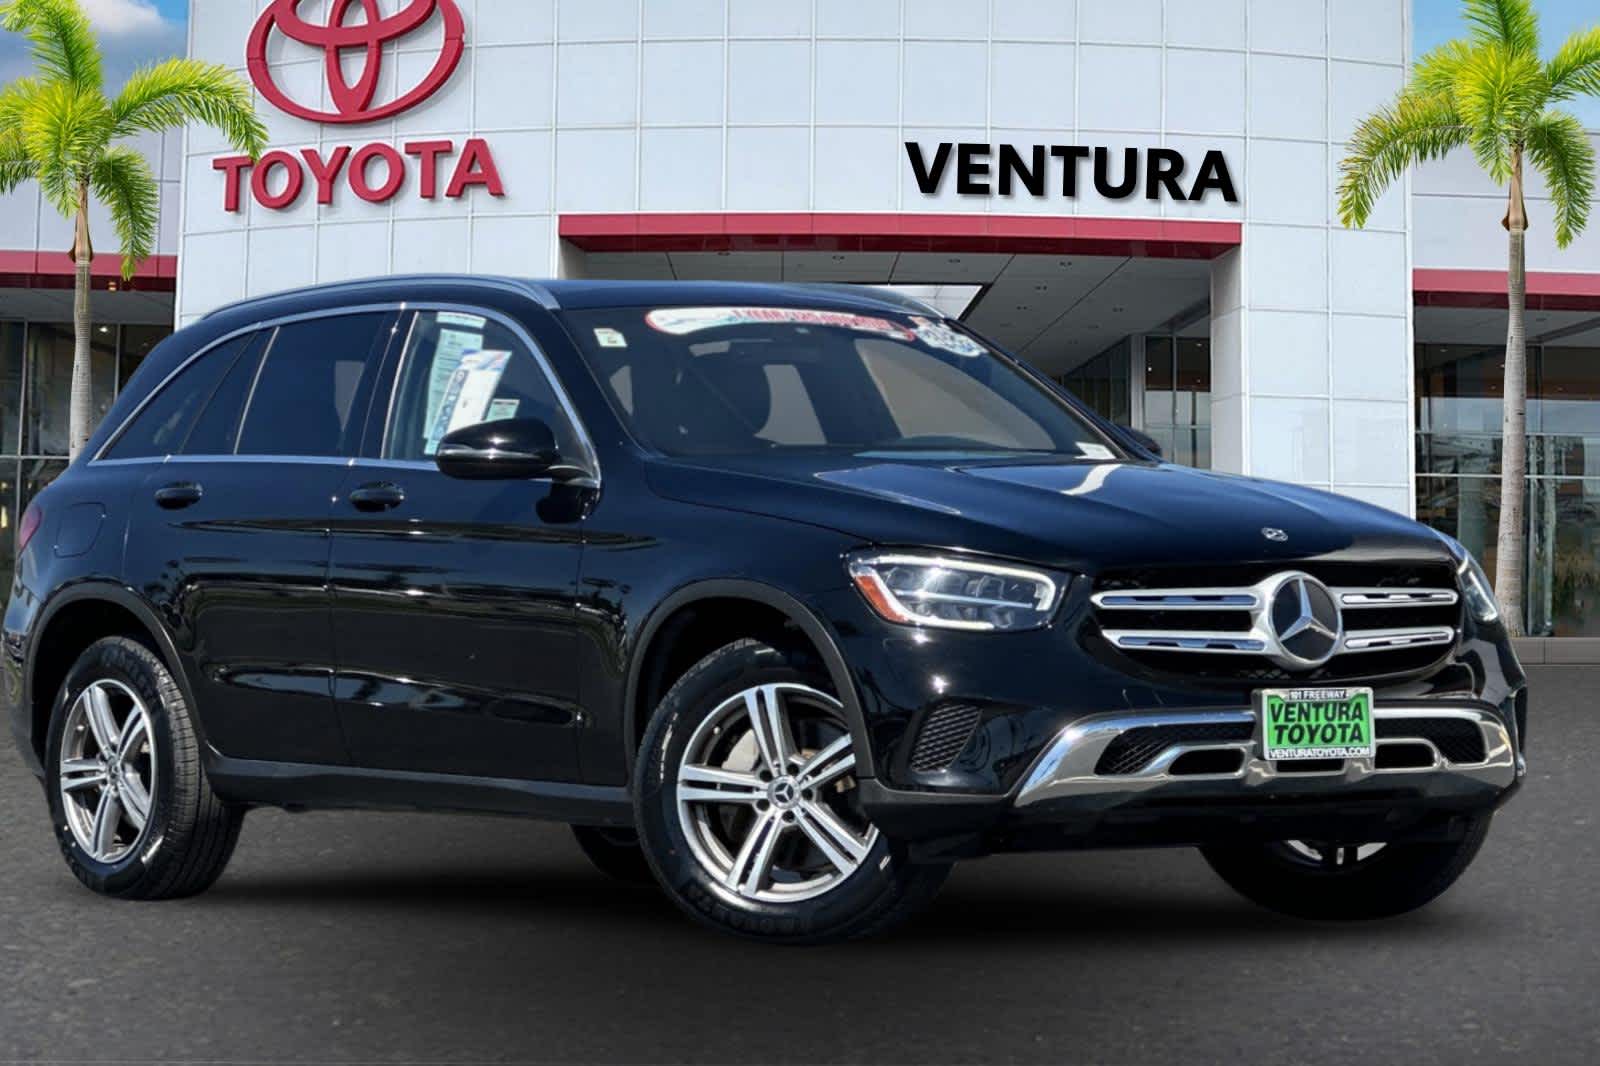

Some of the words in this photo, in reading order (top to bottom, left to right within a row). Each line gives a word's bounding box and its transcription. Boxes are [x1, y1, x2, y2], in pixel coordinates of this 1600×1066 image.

[212, 139, 505, 213] TOYOTA
[904, 141, 1239, 203] VENTURA
[1303, 689, 1345, 699] FREEWAY
[1270, 701, 1364, 723] VENTURA
[1274, 722, 1364, 745] TOYOTA
[1268, 747, 1370, 759] VENTURATOYOTA.COM
